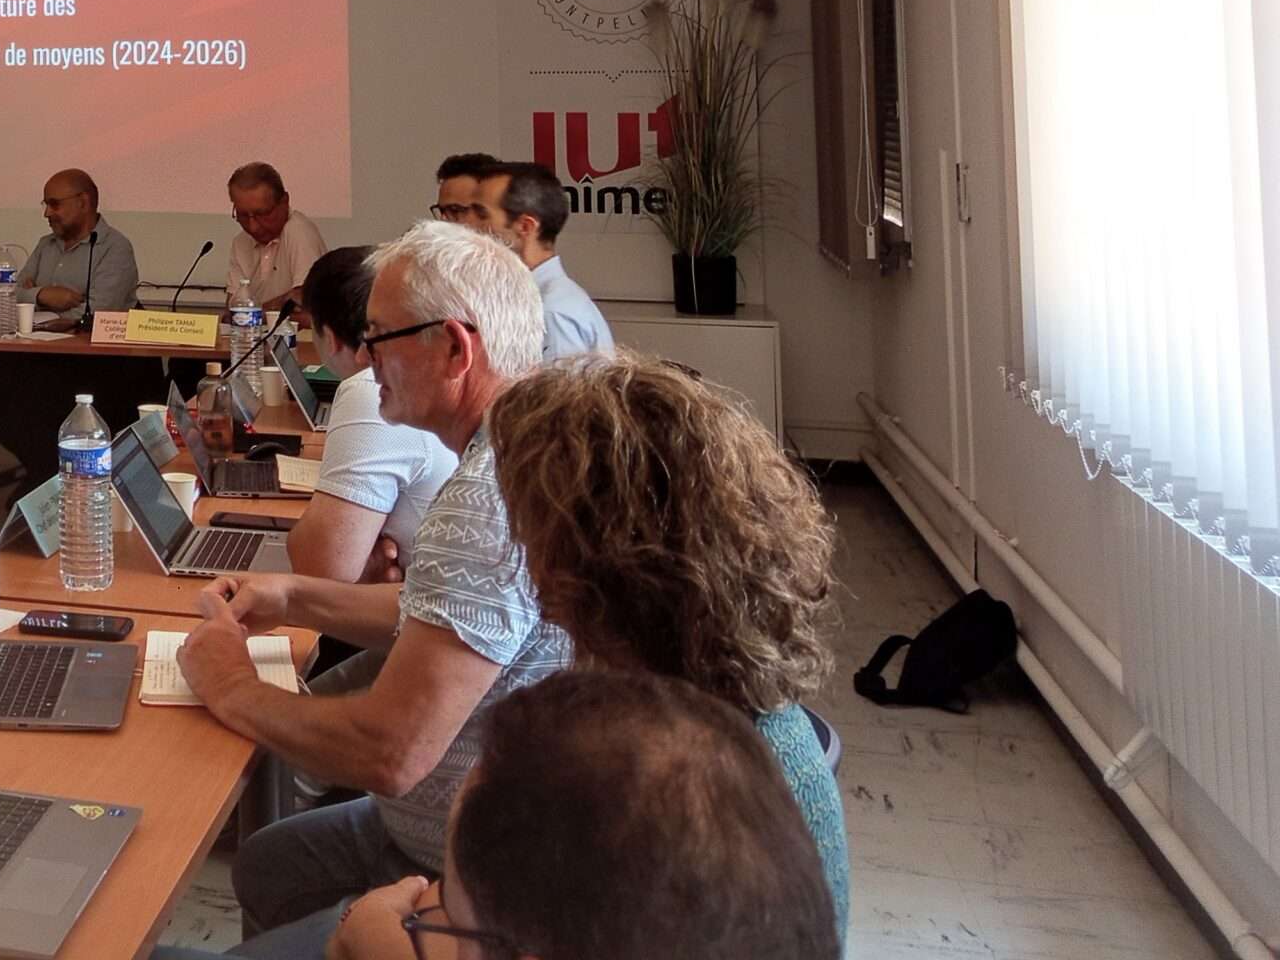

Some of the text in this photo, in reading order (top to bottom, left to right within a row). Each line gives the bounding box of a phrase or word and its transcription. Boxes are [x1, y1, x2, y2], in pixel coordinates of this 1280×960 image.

[4, 42, 27, 67] de
[32, 46, 105, 70] moyens
[111, 39, 247, 71] (2024-2026)
[100, 318, 127, 326] Marie-La
[148, 317, 174, 327] Philippe
[104, 325, 126, 333] Collèg
[138, 324, 169, 333] Président
[179, 327, 205, 335] Conseil
